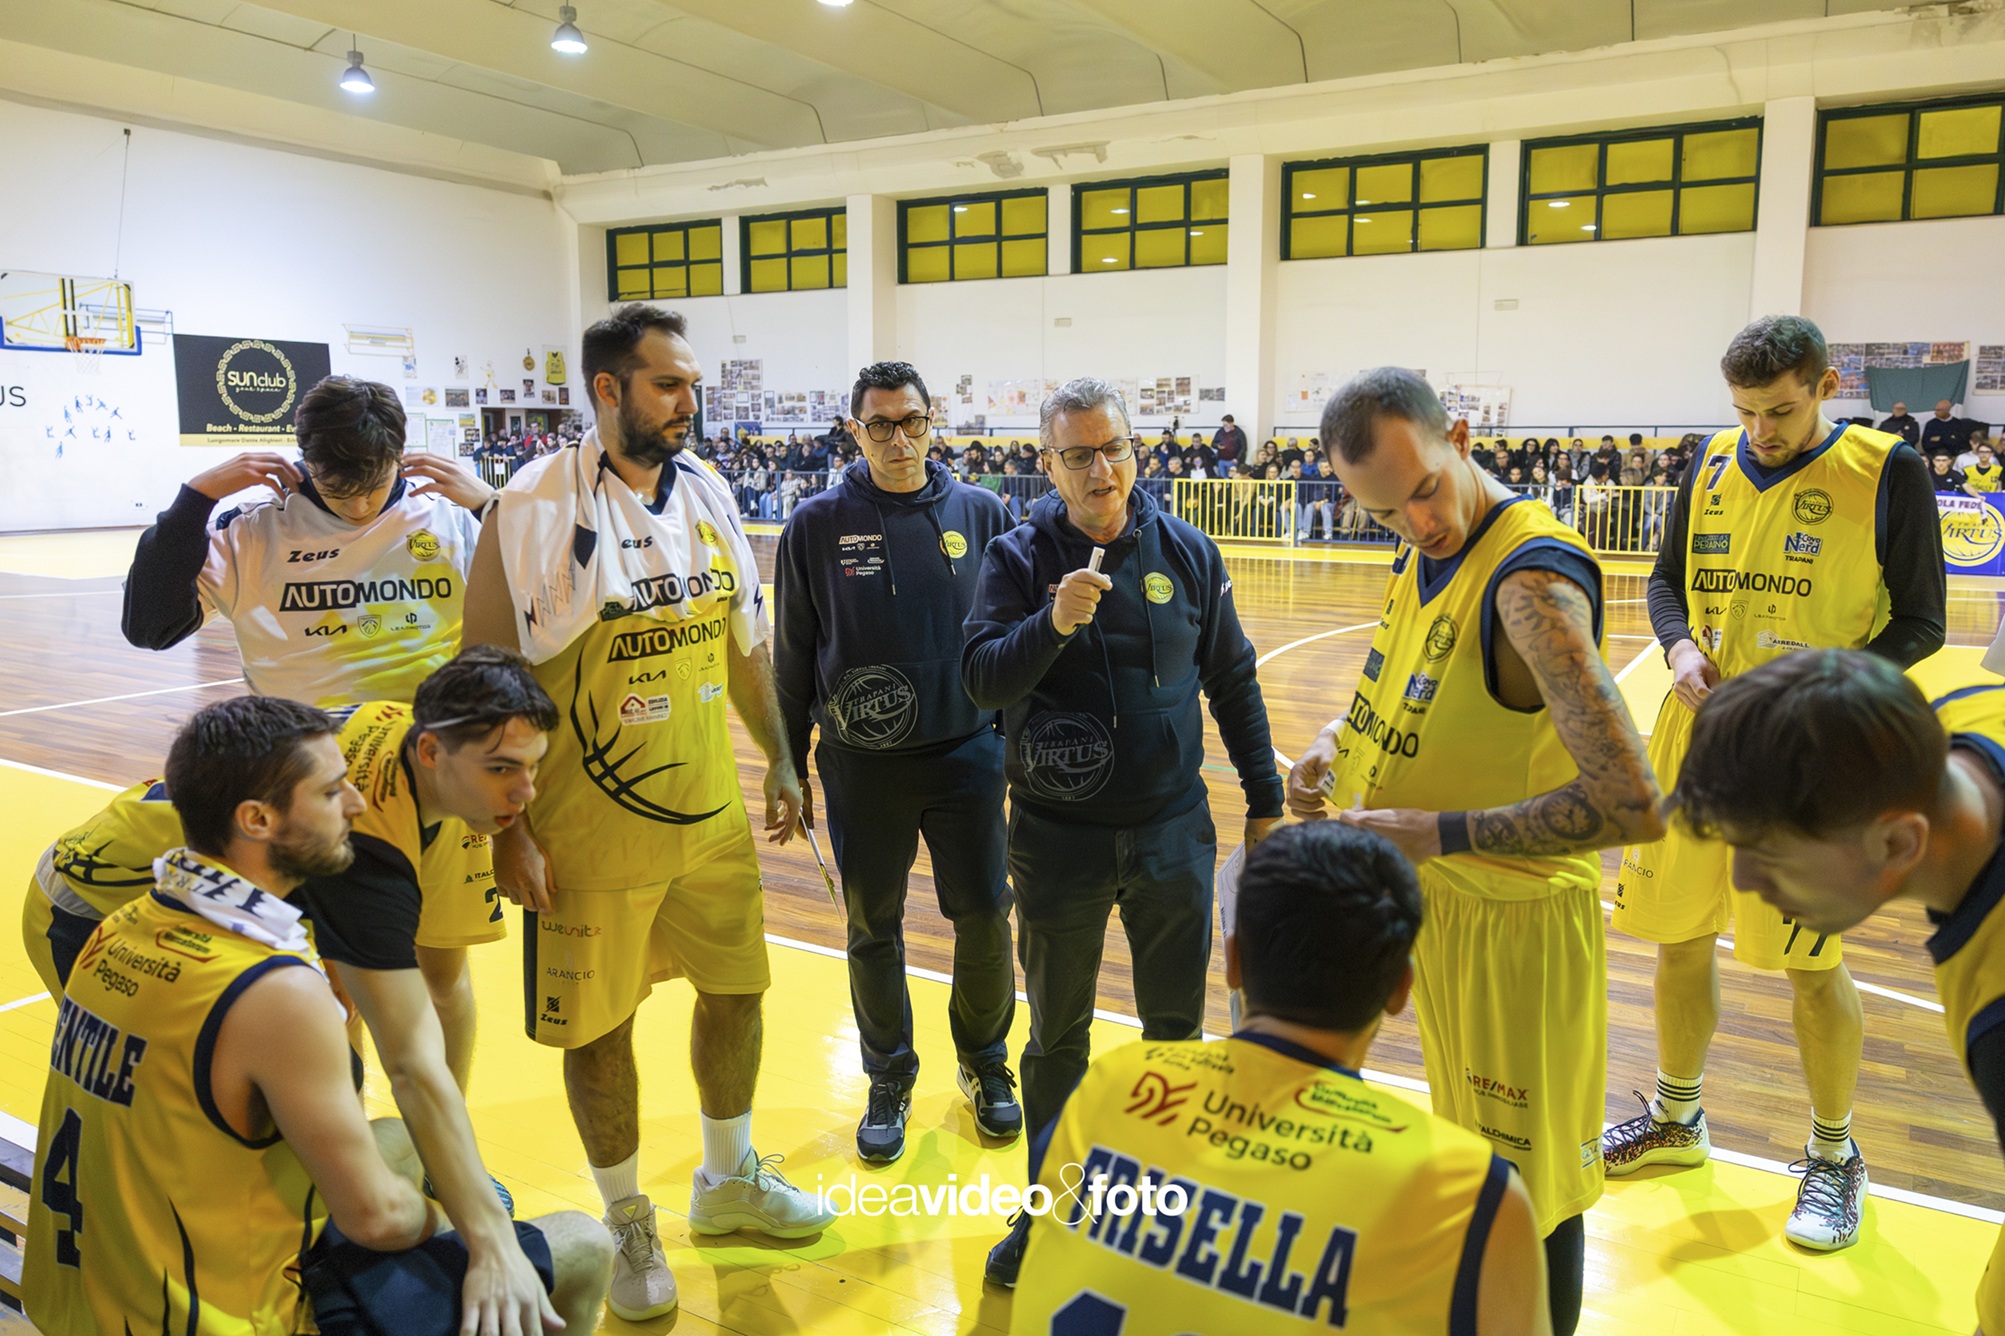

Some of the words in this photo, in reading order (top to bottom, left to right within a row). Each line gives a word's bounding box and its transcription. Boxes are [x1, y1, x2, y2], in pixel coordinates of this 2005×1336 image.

[206, 423, 232, 432] Beach
[238, 423, 281, 433] Restaurant
[1703, 508, 1724, 516] Zeus
[621, 535, 653, 549] eus
[839, 534, 883, 545] AUTOMONDO
[287, 549, 340, 563] Zeus
[1785, 555, 1814, 565] TRAPANI
[1691, 568, 1813, 598] AUTOMONDO
[279, 578, 452, 612] AUTOMONDO
[304, 625, 348, 637] KIA
[1772, 639, 1810, 649] AIREDALL
[629, 670, 667, 684] KIA
[853, 683, 896, 705] TRAPANI
[828, 685, 912, 731] VIRTUS
[1021, 741, 1109, 773] VIRTUS
[107, 937, 181, 983] Università
[92, 957, 139, 998] Pegaso
[547, 966, 596, 981] ARANCIO
[541, 1013, 568, 1026] Zeus
[1473, 1074, 1529, 1101] RE/MAX
[1202, 1089, 1374, 1154] Università
[1186, 1116, 1313, 1172] Pegaso
[42, 1107, 84, 1270] 4
